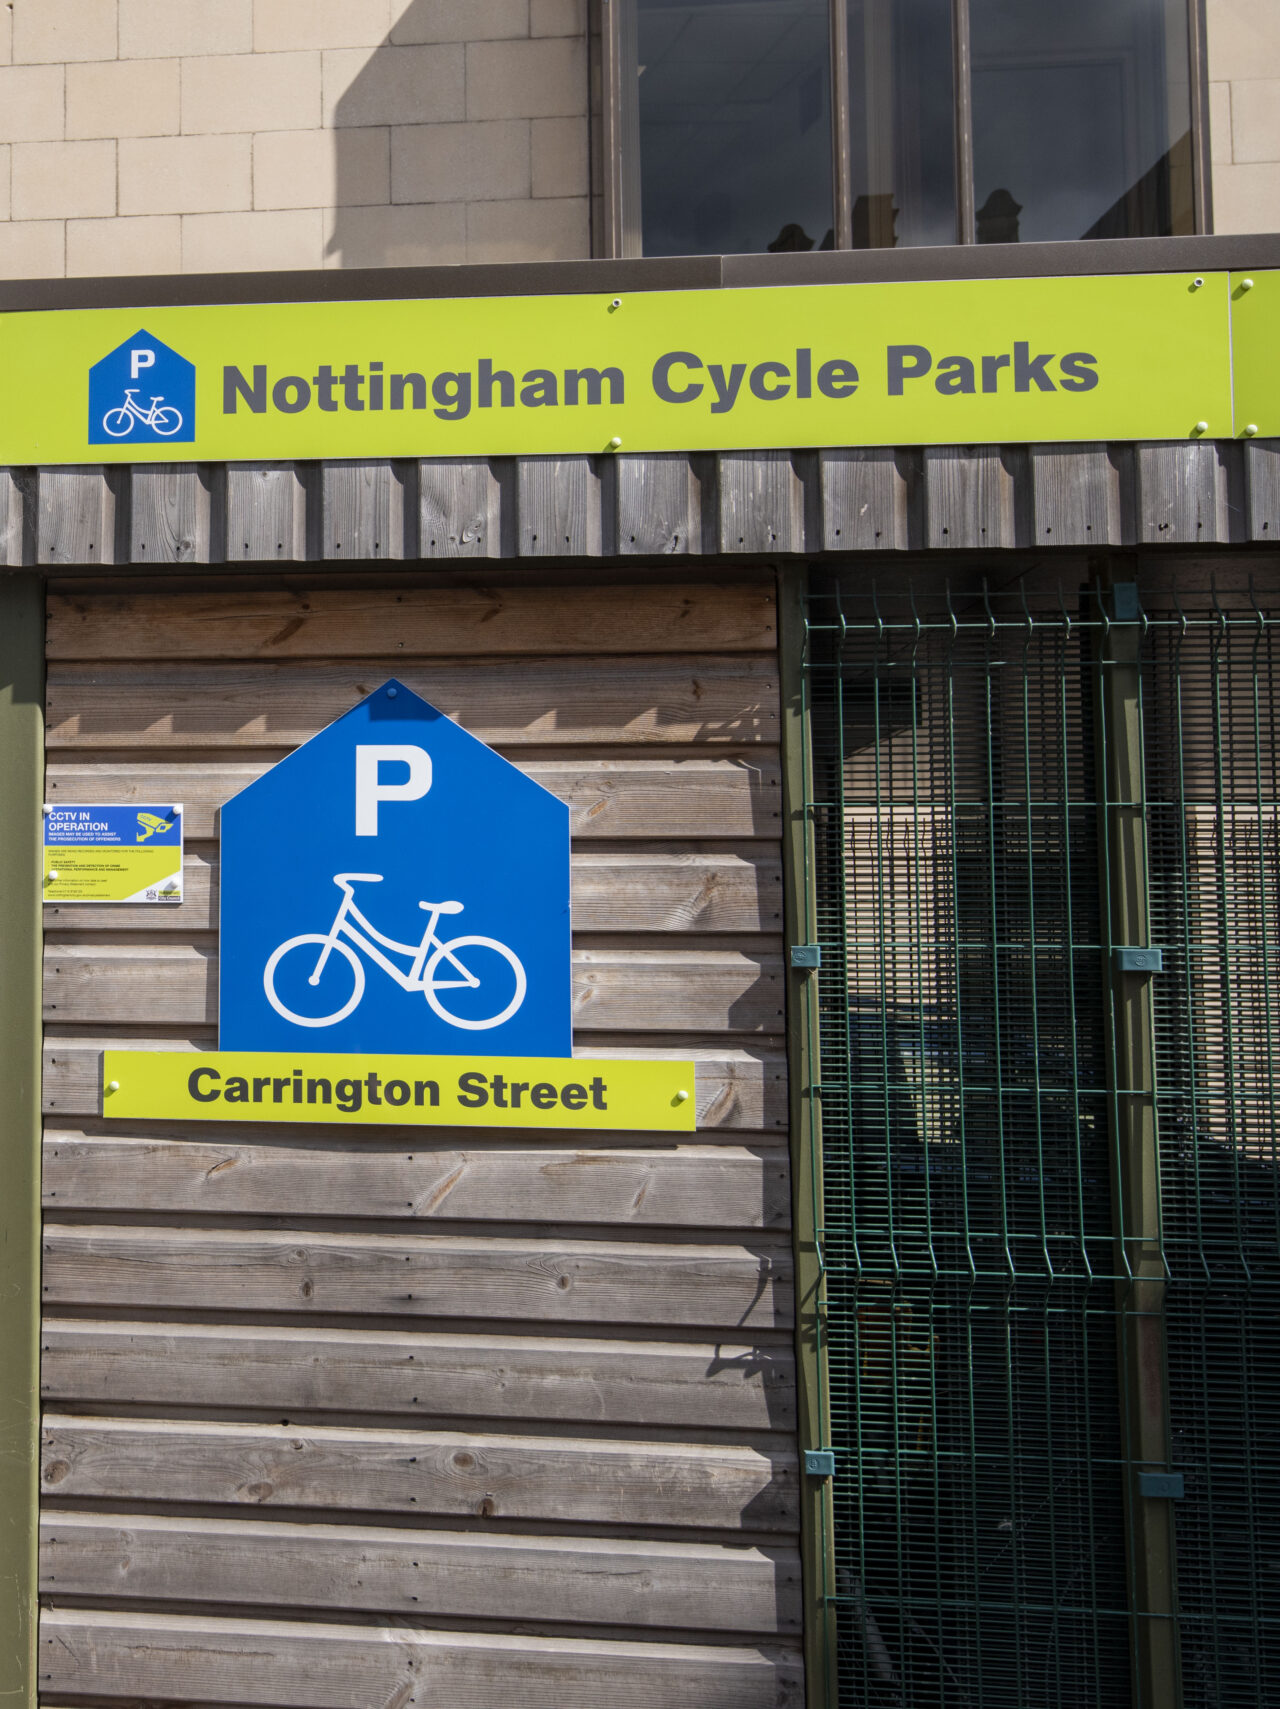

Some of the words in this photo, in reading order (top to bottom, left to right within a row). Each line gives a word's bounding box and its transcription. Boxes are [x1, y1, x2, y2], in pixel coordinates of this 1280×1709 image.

[130, 349, 156, 379] P
[222, 358, 625, 421] Nottingham
[651, 347, 860, 414] Cycle
[886, 340, 1099, 396] Parks
[355, 744, 433, 836] P
[48, 812, 77, 821] CCTV
[79, 811, 90, 821] IN
[48, 822, 108, 831] OPERATION
[187, 1066, 440, 1113] Carrington
[456, 1071, 608, 1111] Street
